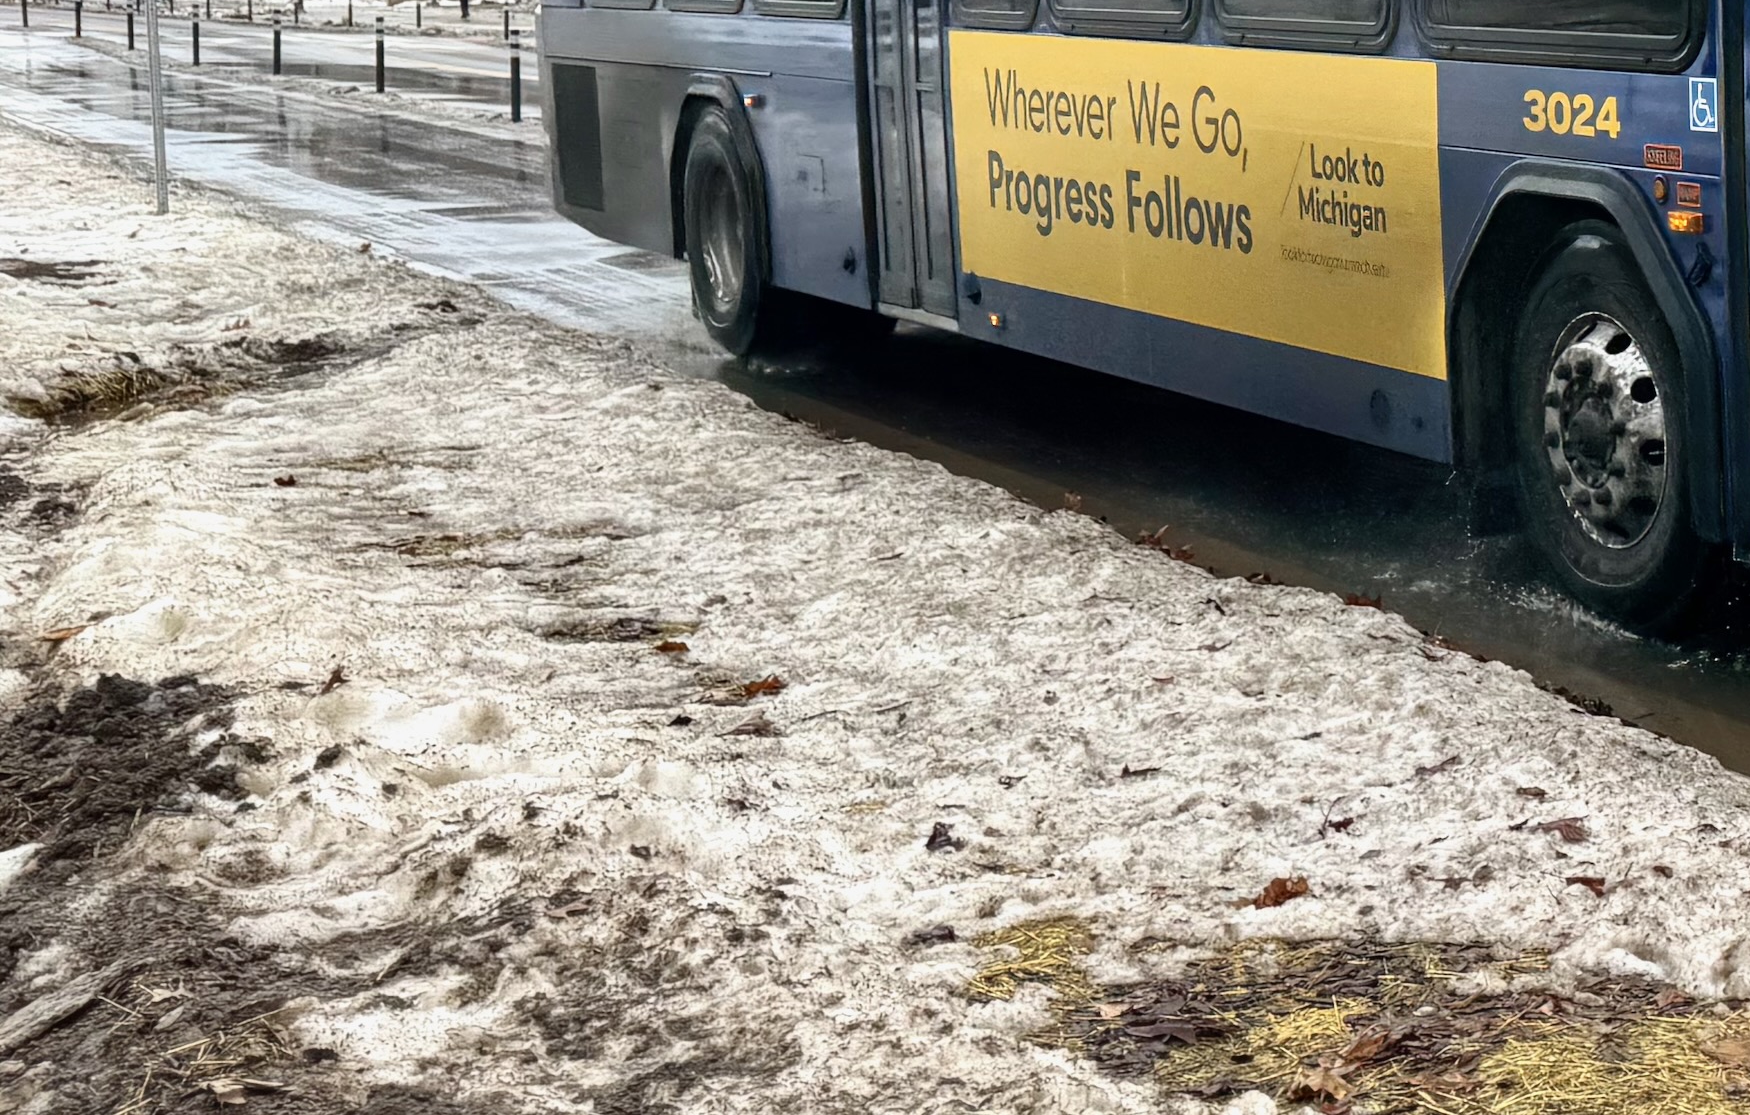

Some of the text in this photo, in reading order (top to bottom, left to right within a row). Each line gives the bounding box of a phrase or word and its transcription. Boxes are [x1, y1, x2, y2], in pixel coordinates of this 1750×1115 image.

[983, 67, 1249, 173] Wherever We Go,
[1522, 89, 1621, 139] 3024
[1309, 143, 1385, 188] Look to
[987, 150, 1254, 255] Progress Follows
[1297, 185, 1388, 239] Michigan
